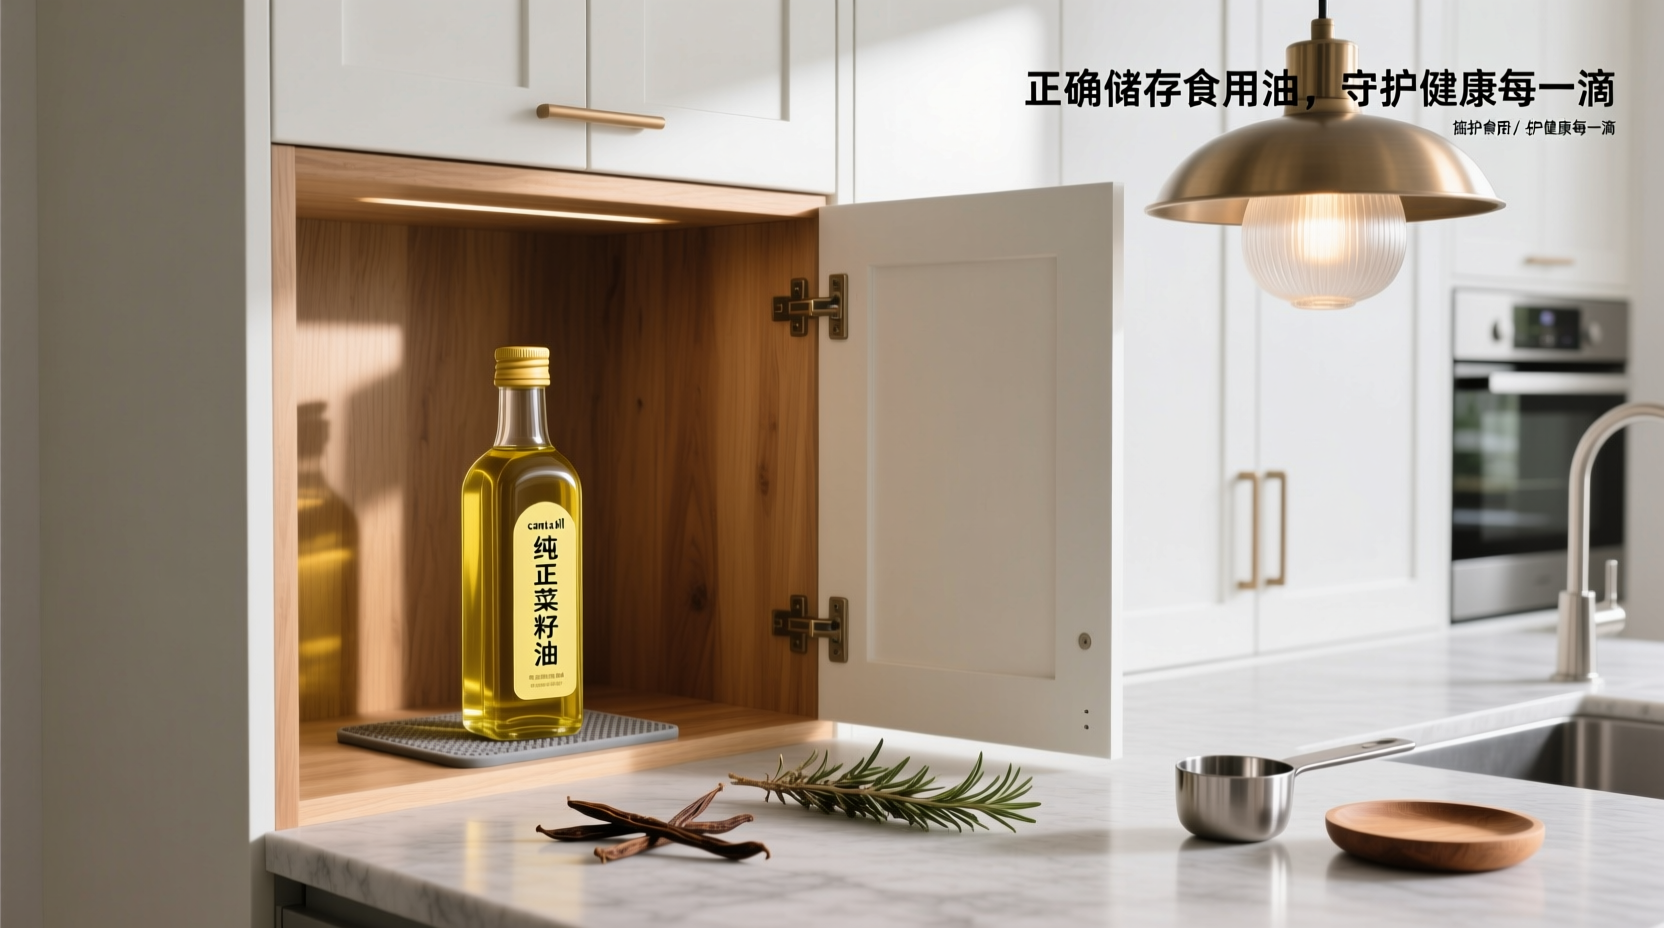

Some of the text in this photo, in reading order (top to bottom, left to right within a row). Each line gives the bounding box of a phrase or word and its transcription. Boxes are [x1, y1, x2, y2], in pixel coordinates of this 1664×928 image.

[533, 535, 559, 667] 纯正菜籽油
